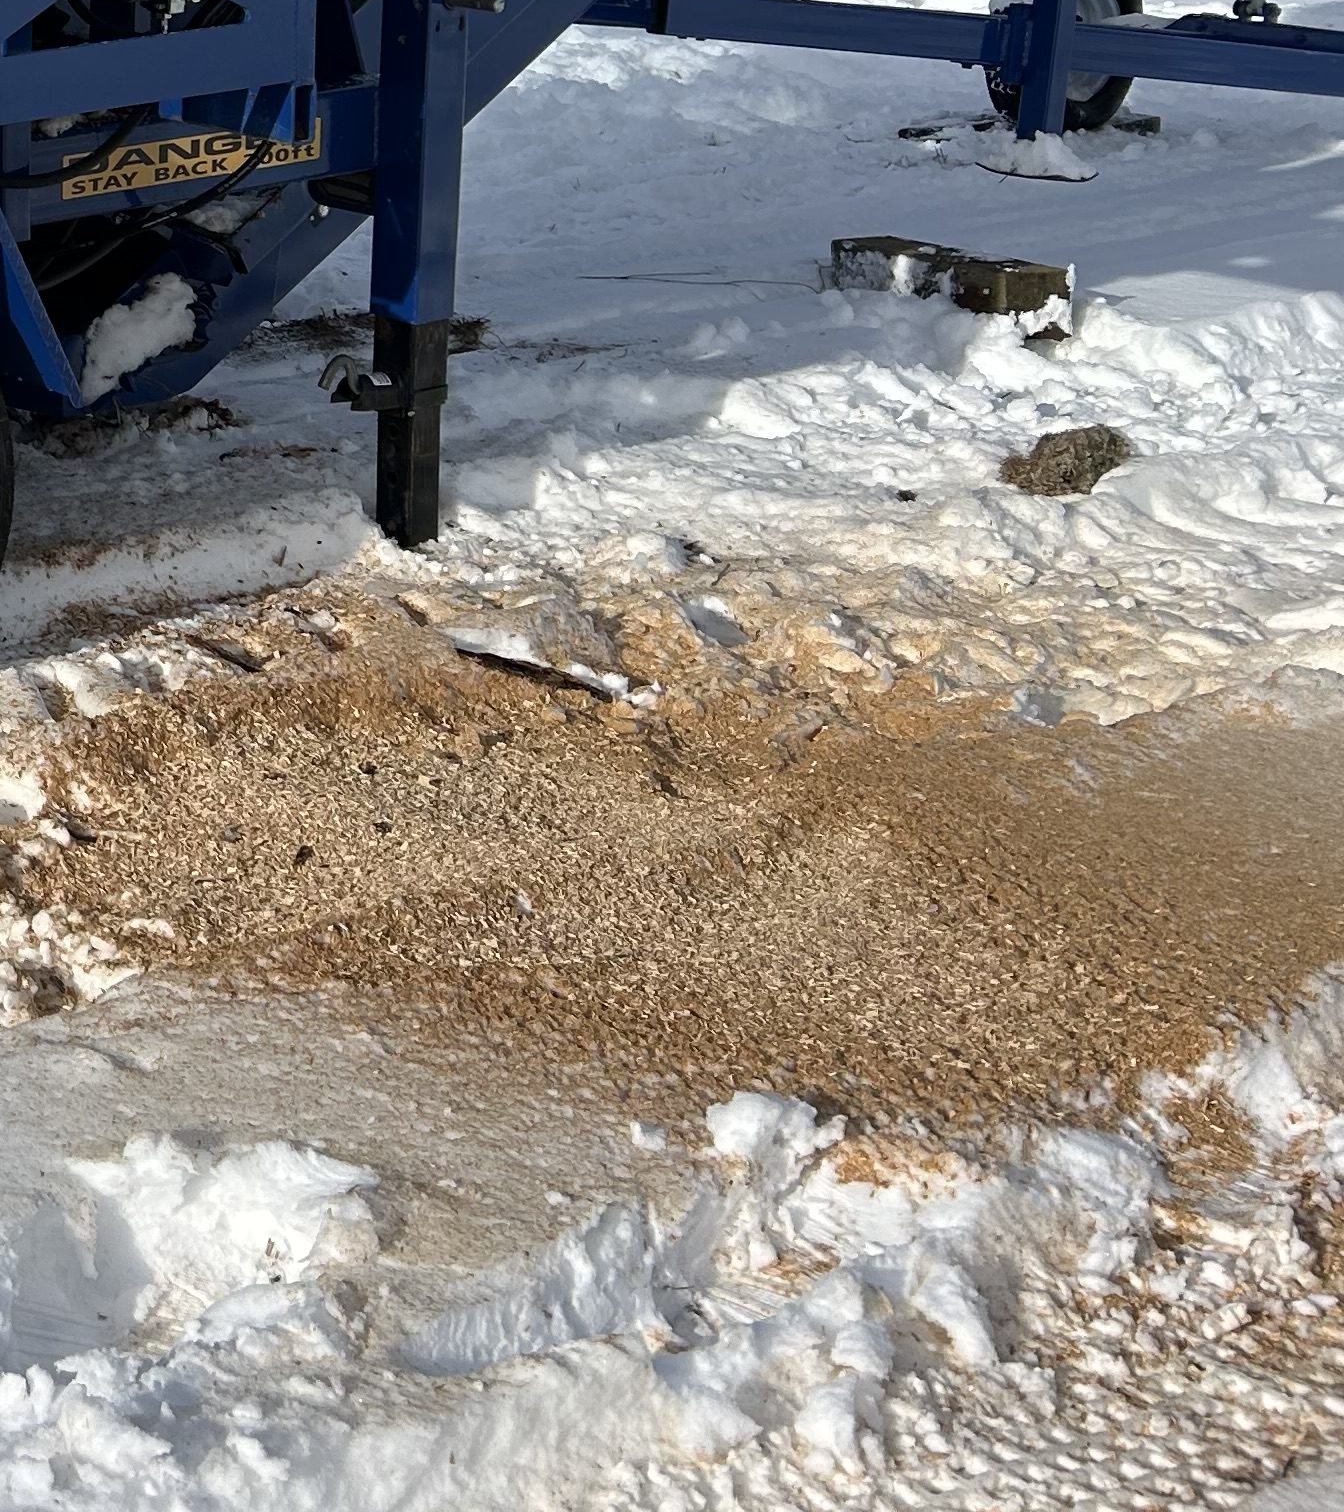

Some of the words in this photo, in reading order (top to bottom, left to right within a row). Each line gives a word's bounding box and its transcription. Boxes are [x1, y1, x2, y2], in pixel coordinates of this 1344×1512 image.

[69, 133, 278, 176] ANG
[71, 171, 138, 195] STAY
[154, 157, 229, 181] BACK
[243, 145, 314, 165] 00ft
